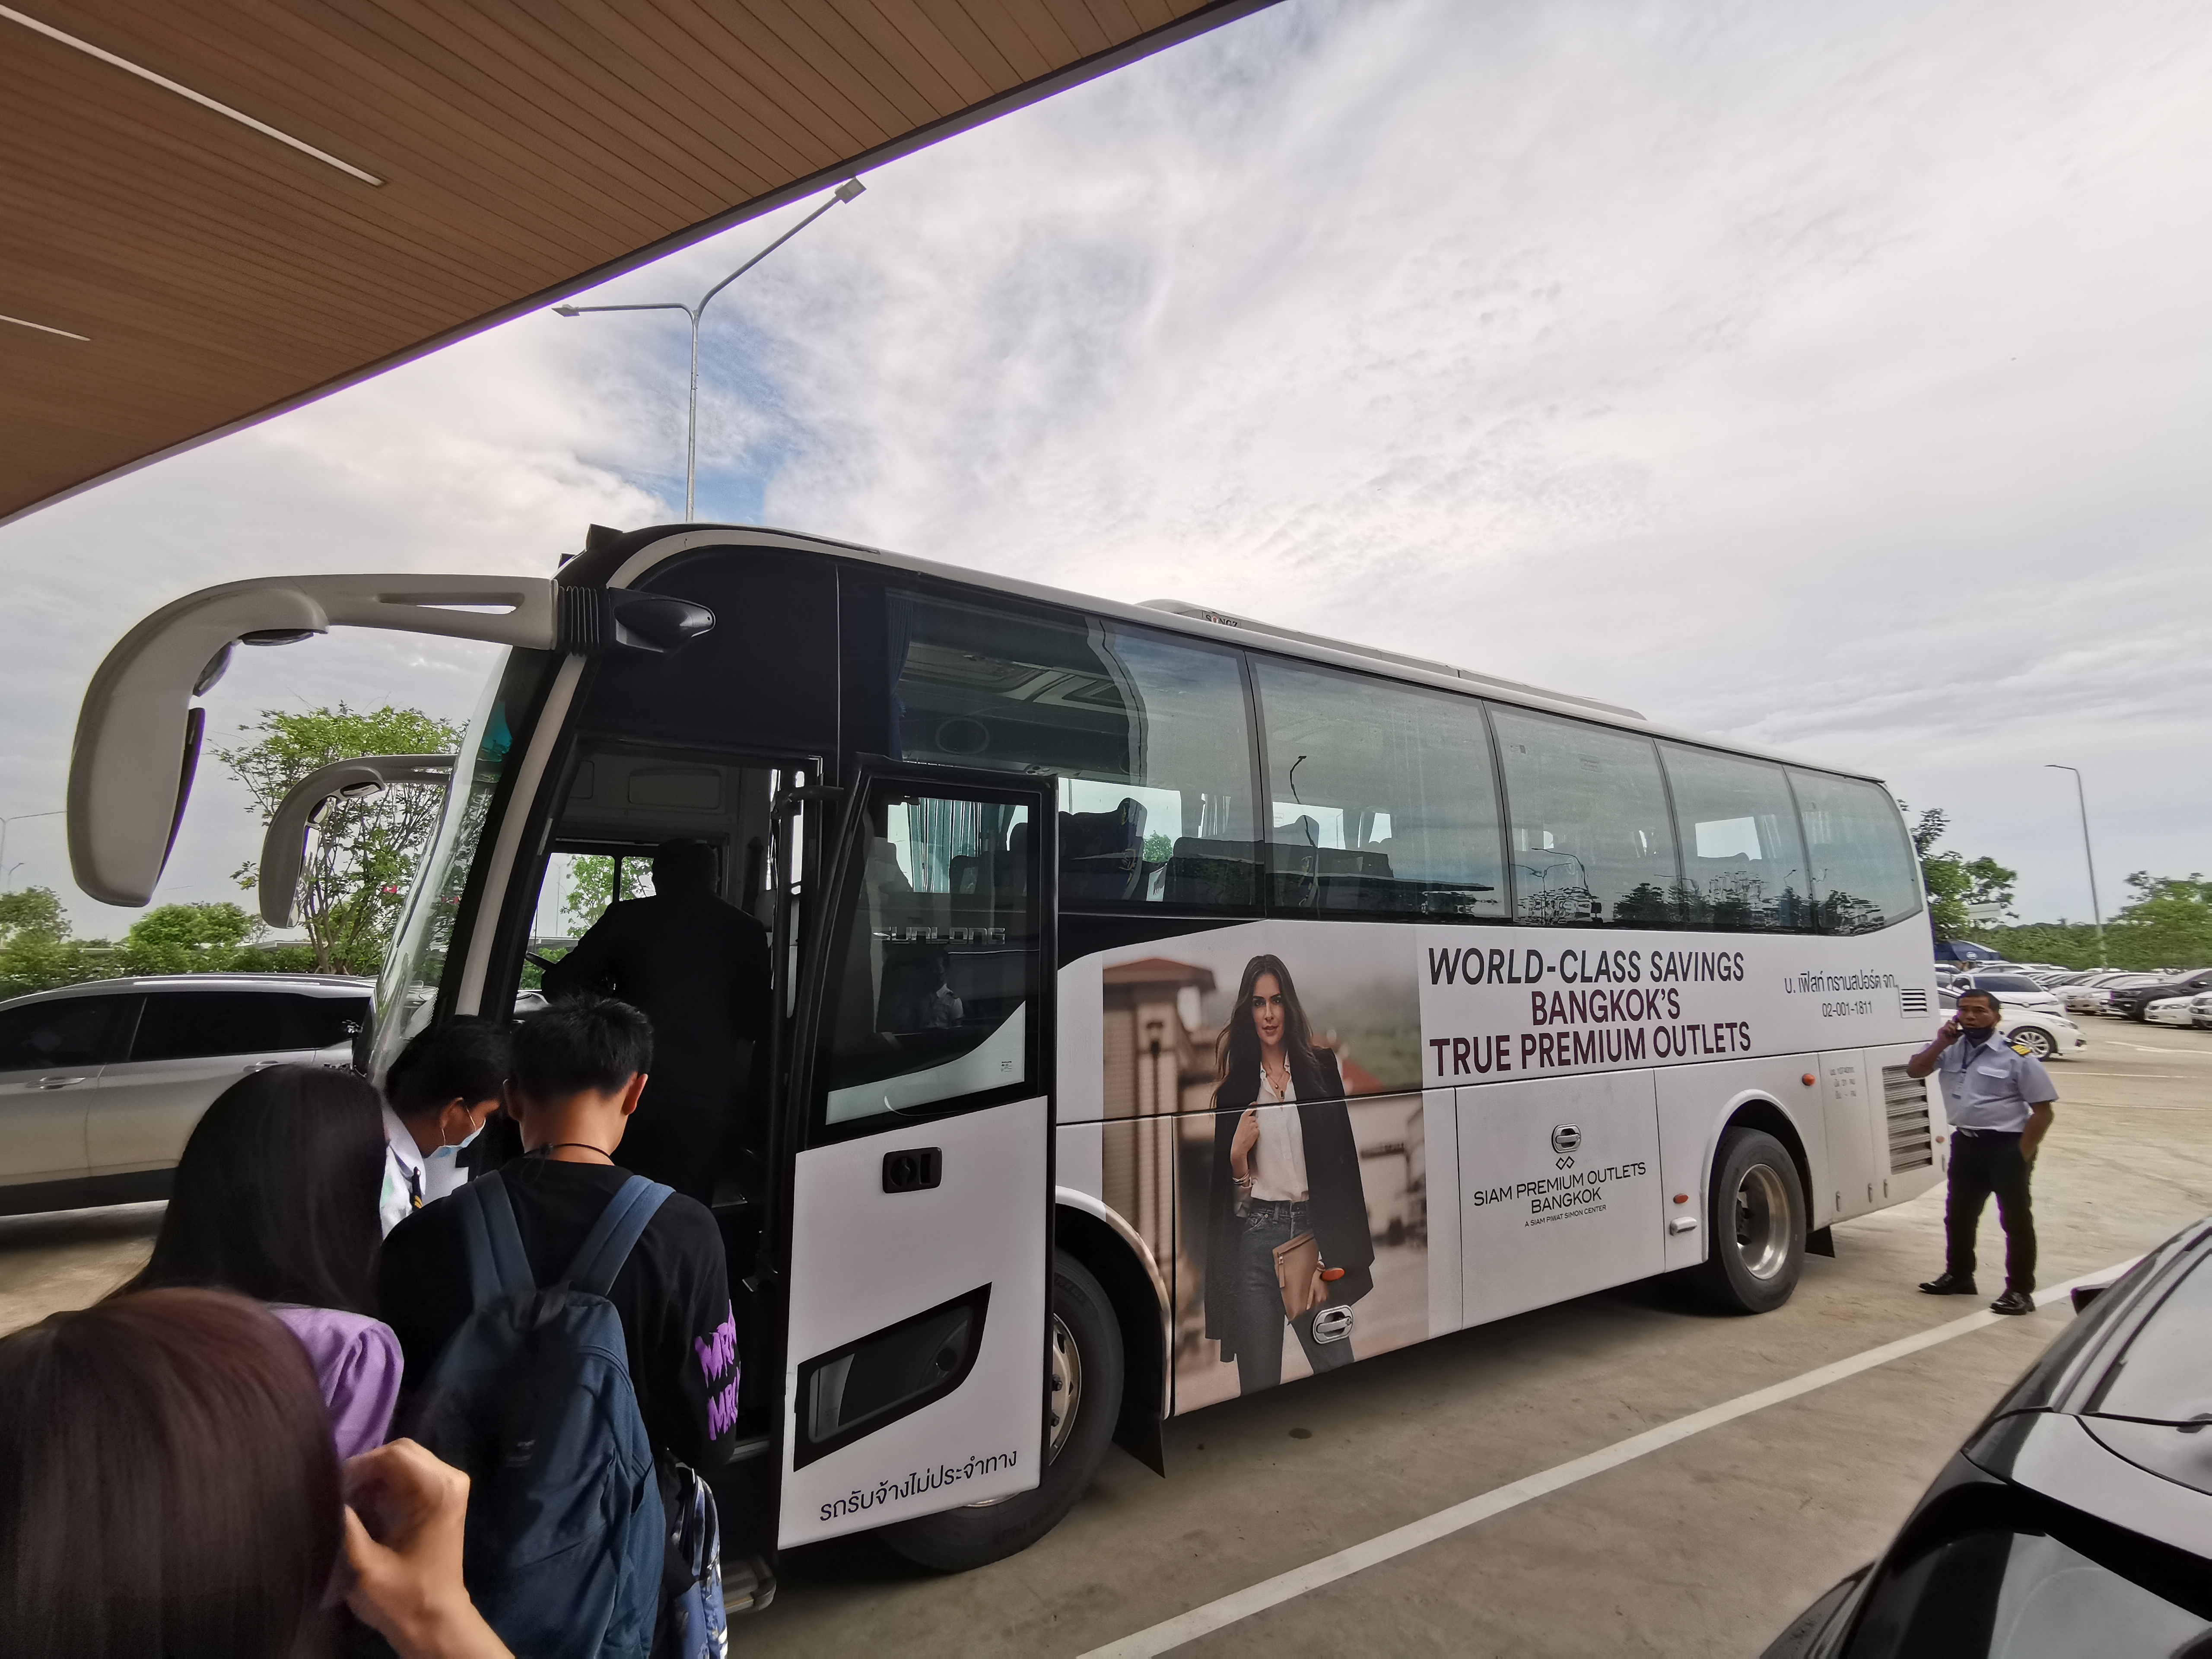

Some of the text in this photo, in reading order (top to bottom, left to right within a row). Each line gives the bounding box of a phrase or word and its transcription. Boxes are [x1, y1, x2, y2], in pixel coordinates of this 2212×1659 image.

[1428, 947, 1744, 985] WORLD-CLASS SAVINGS
[1784, 977, 1796, 994] บ.
[1531, 988, 1681, 1026] BANGKOK'S
[1822, 1000, 1873, 1017] 02-001-1811
[1429, 1021, 1751, 1077] TRUE PREMIUM OUTLETS
[1474, 1161, 1646, 1207] SIAM PREMIUM OUTLETS
[1531, 1186, 1602, 1214] BANGKOK
[1530, 1217, 1546, 1227] SIAM
[1564, 1209, 1584, 1220] SIMON
[1584, 1204, 1607, 1215] CENTER
[819, 1450, 1017, 1522] รถรับจ้างไม่ประจำทาง
